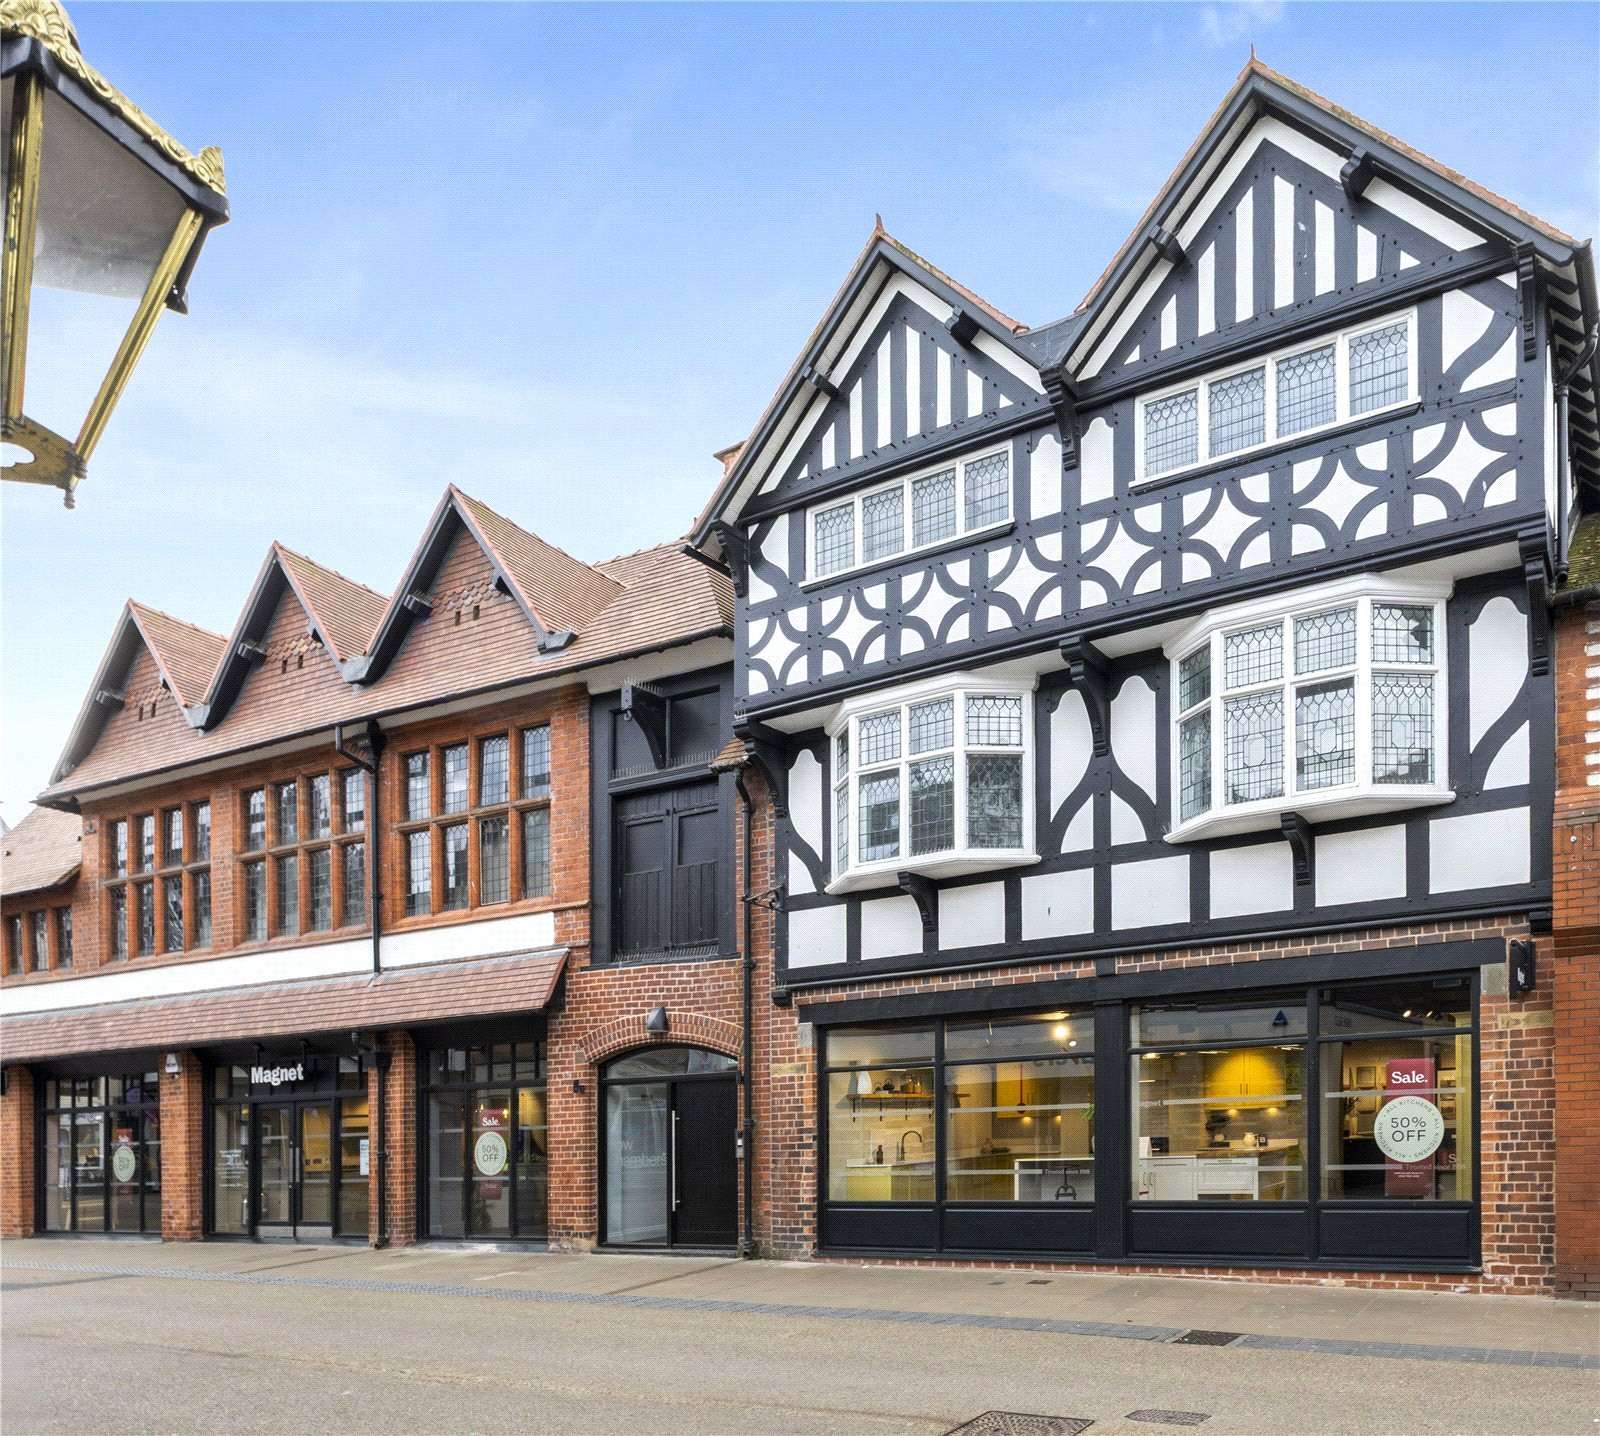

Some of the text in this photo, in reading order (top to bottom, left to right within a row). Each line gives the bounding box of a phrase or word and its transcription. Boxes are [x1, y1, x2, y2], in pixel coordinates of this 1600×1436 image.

[251, 1063, 304, 1086] Magnet
[1391, 1071, 1428, 1084] Sale.
[1391, 1116, 1426, 1129] 50%
[1391, 1129, 1426, 1142] OFF
[482, 1153, 499, 1162] OFF
